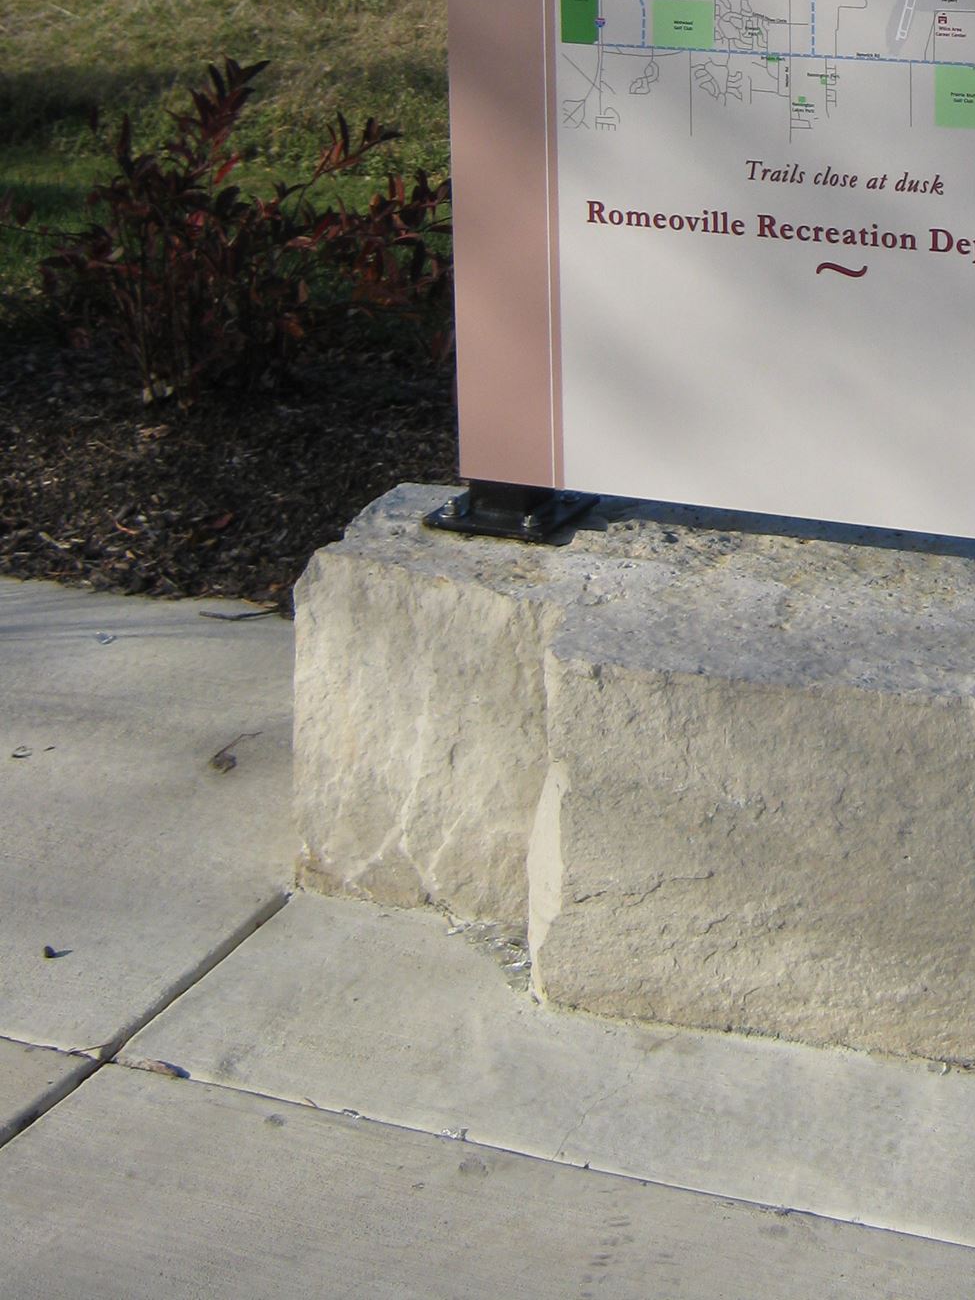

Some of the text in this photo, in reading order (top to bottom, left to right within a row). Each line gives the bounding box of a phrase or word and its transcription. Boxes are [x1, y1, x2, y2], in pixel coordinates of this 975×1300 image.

[745, 160, 945, 196] Trails close at dusk
[586, 201, 745, 237] Romeoville
[757, 214, 917, 251] Recreation
